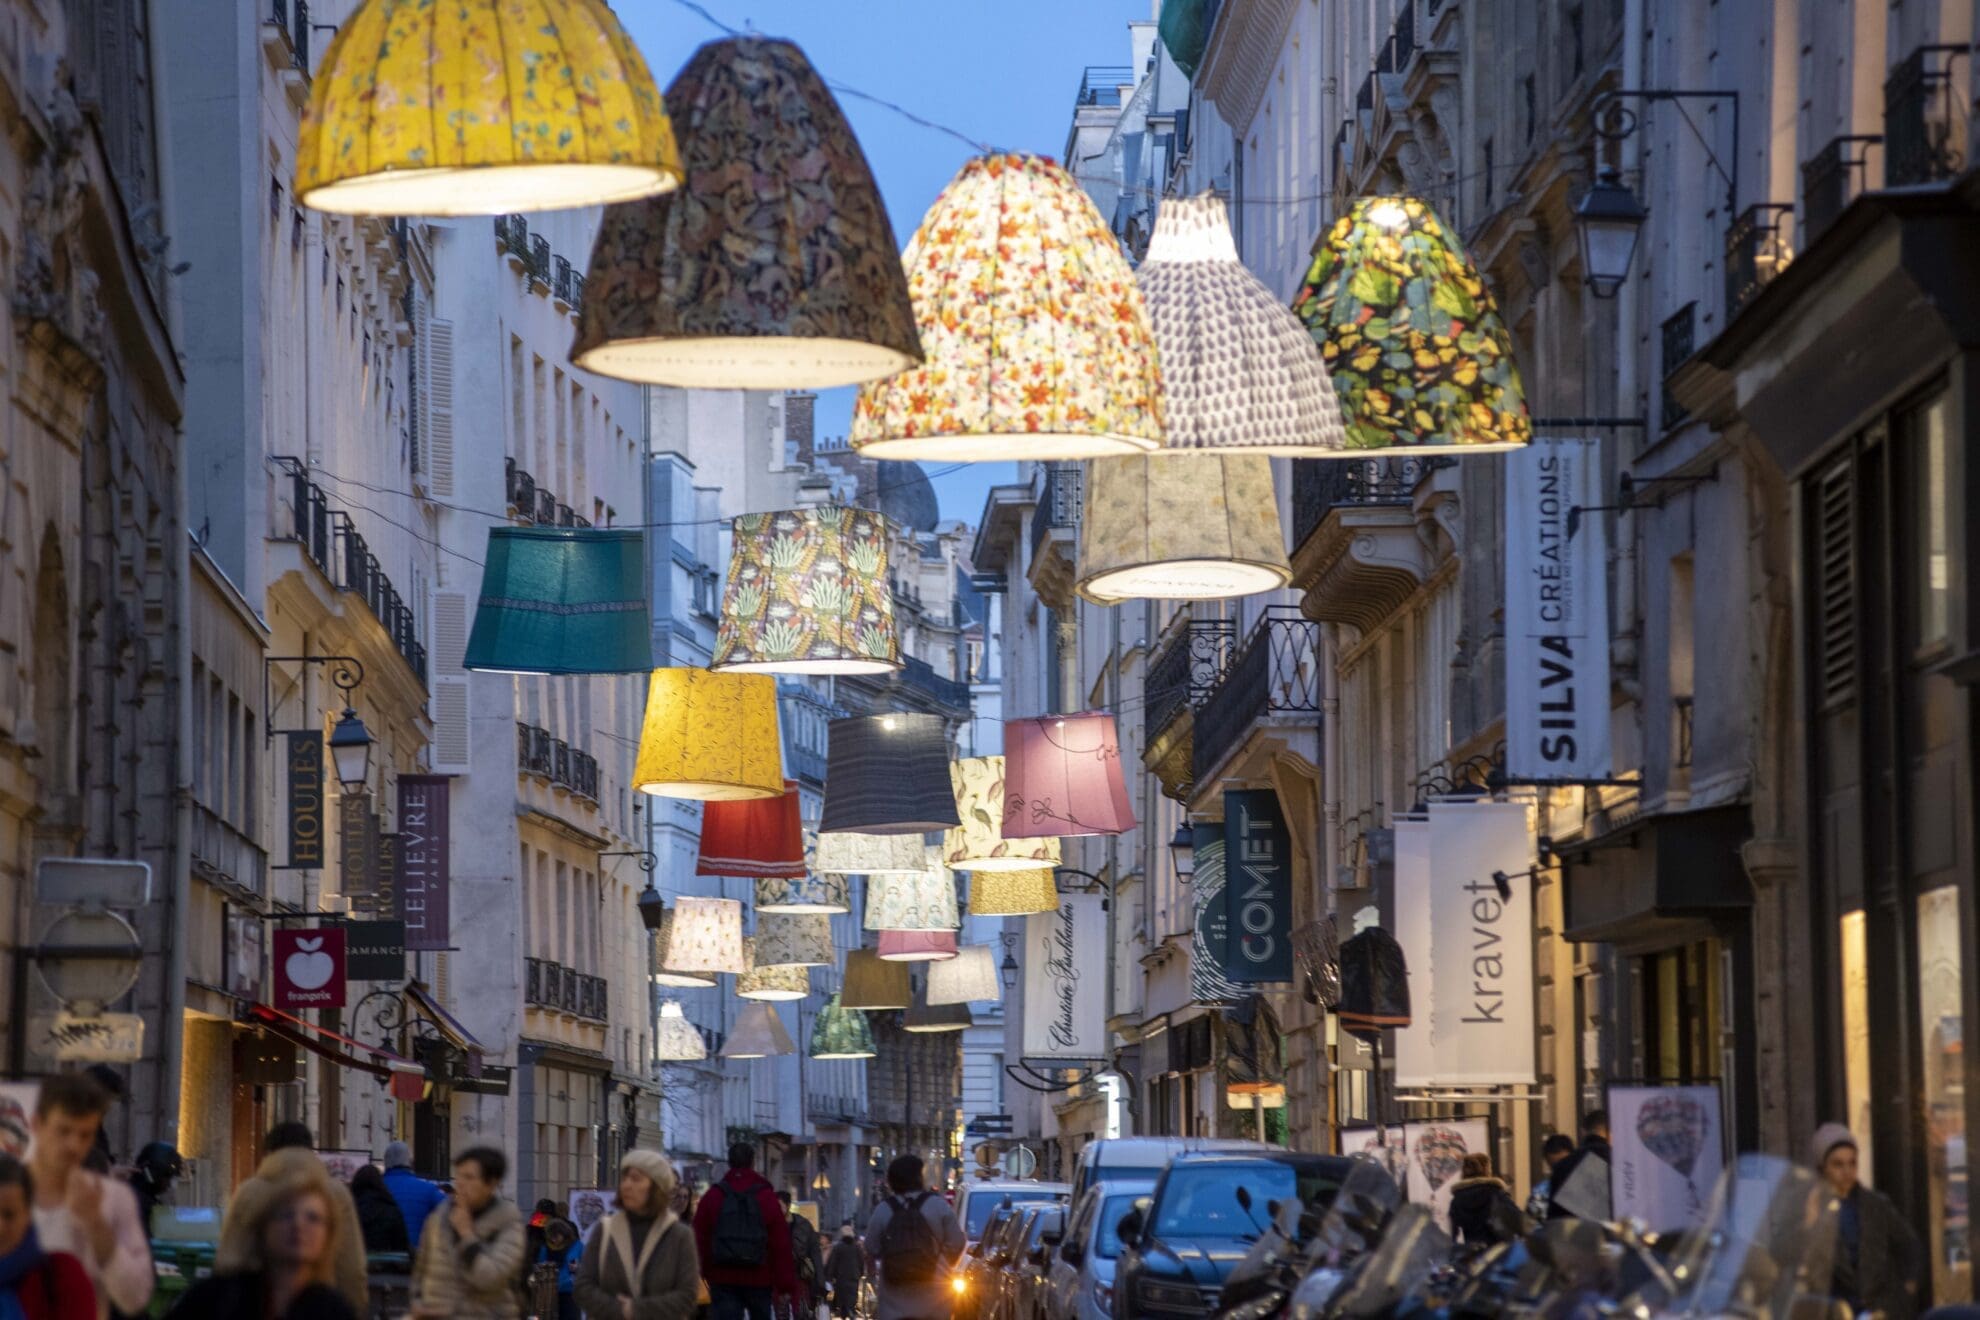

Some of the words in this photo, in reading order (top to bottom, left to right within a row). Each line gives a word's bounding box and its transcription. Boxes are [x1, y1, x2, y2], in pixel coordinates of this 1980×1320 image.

[1533, 456, 1560, 622] CRÉATIONS
[1540, 636, 1577, 763] SILVA
[405, 794, 426, 929] LELIEVRE
[430, 835, 439, 889] PARIS
[1240, 805, 1279, 963] COMET
[288, 990, 332, 1003] franprix
[1043, 903, 1081, 987] Fischbacher
[1461, 880, 1504, 1024] kravet
[1047, 985, 1079, 1051] Christian
